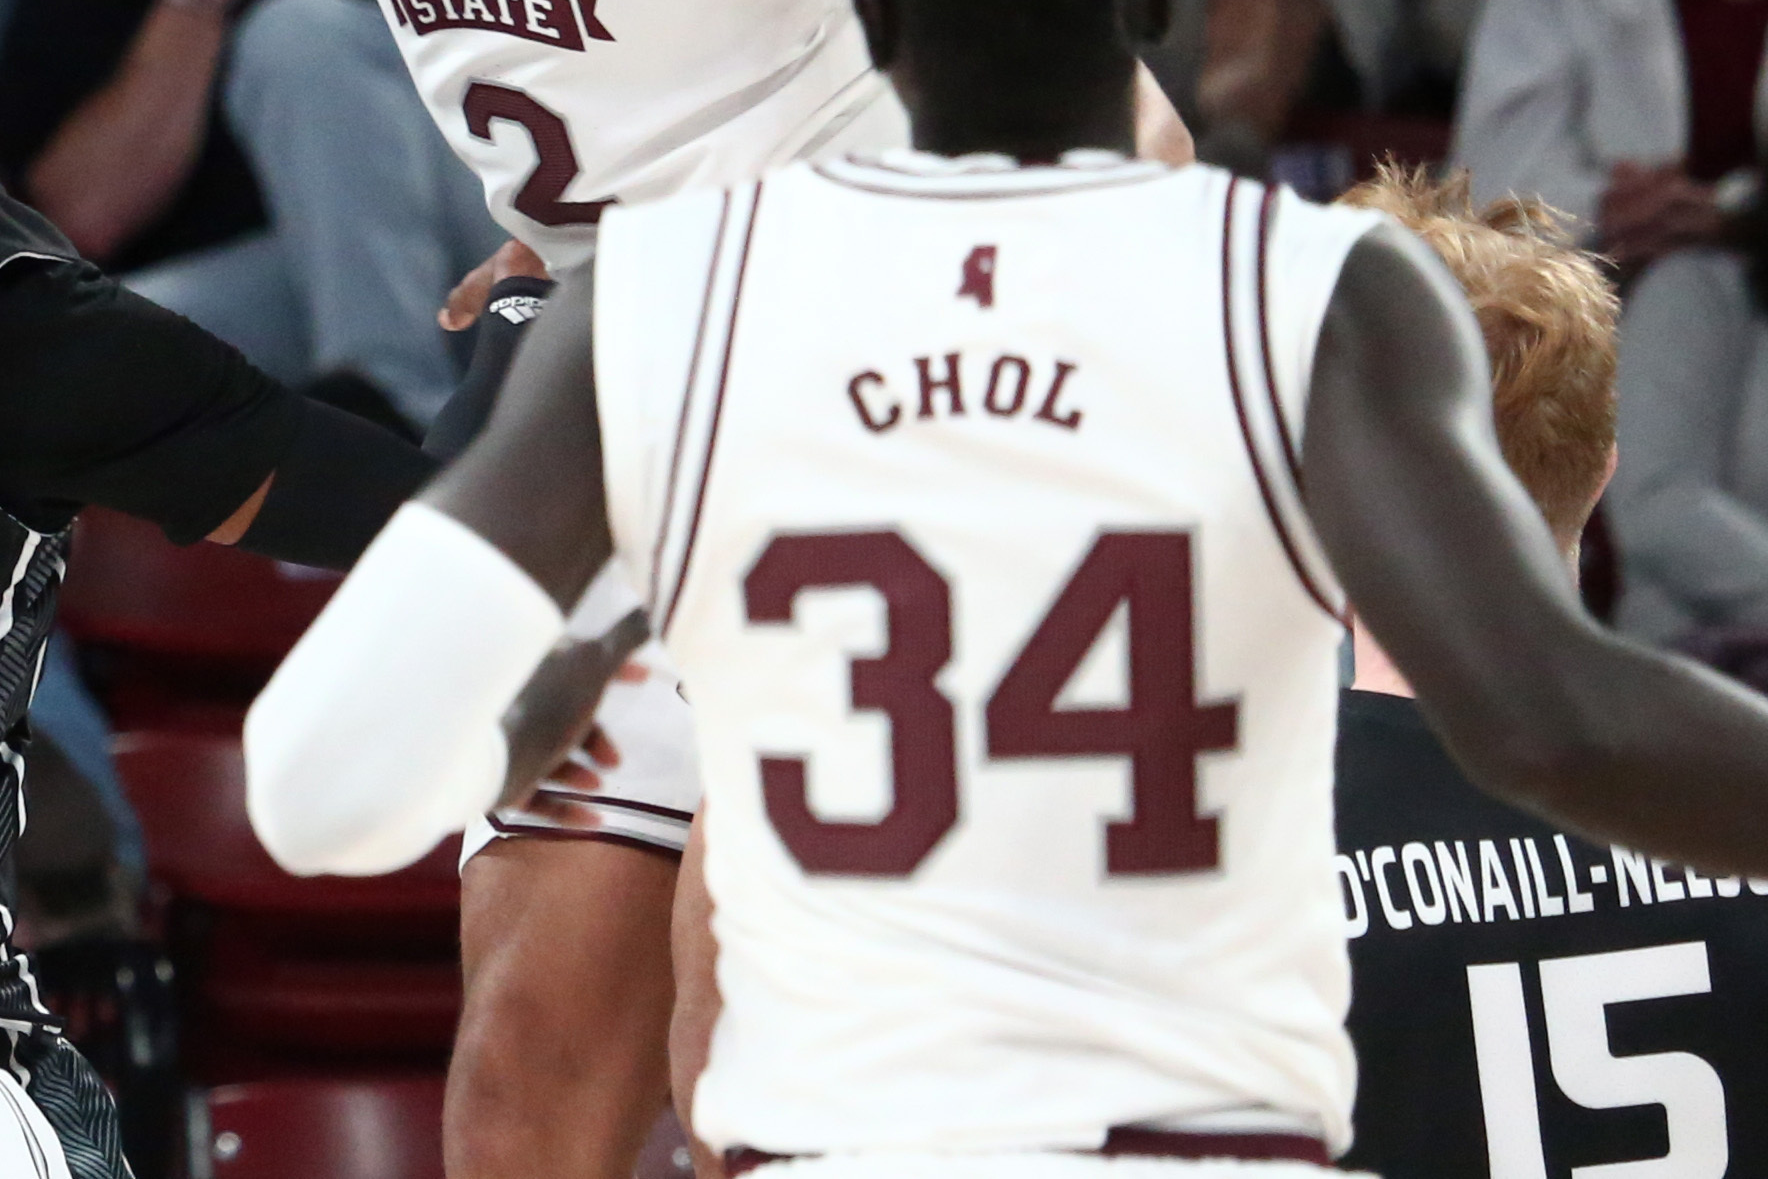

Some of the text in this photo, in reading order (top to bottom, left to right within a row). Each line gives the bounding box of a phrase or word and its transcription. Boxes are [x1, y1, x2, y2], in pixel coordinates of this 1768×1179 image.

[462, 81, 619, 227] 2
[846, 351, 1085, 435] CHOL
[739, 529, 1243, 880] 34
[1466, 940, 1730, 1179] 15
